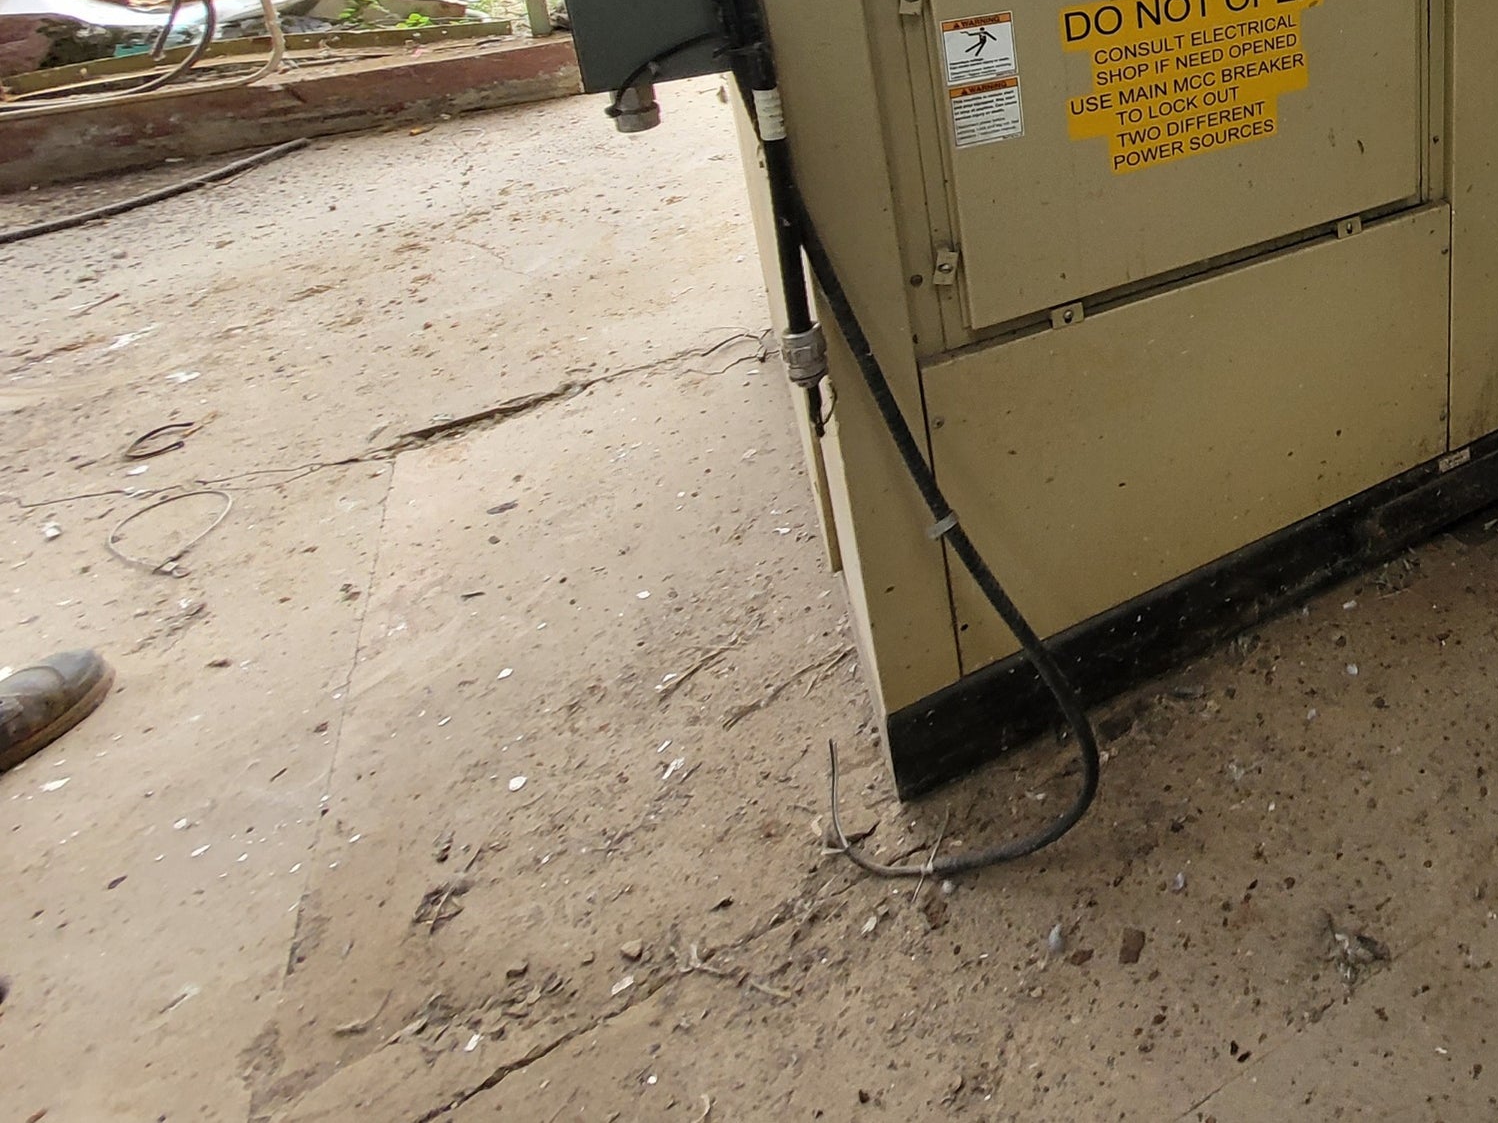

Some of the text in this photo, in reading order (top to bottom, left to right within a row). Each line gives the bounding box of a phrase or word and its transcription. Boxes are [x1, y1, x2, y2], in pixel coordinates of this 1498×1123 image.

[961, 16, 1000, 26] WARNING
[1064, 5, 1122, 42] DO
[1094, 14, 1297, 65] CONSULT ELECTRICAL
[1096, 33, 1297, 85] SHOP IF NEED OPENED
[1070, 53, 1304, 115] USE MAIN MCC BREAKER
[1116, 86, 1239, 125] TO LOCK OUT
[1113, 119, 1274, 169] POWER SOURCES
[1116, 101, 1266, 147] TWO DIFFERENT
